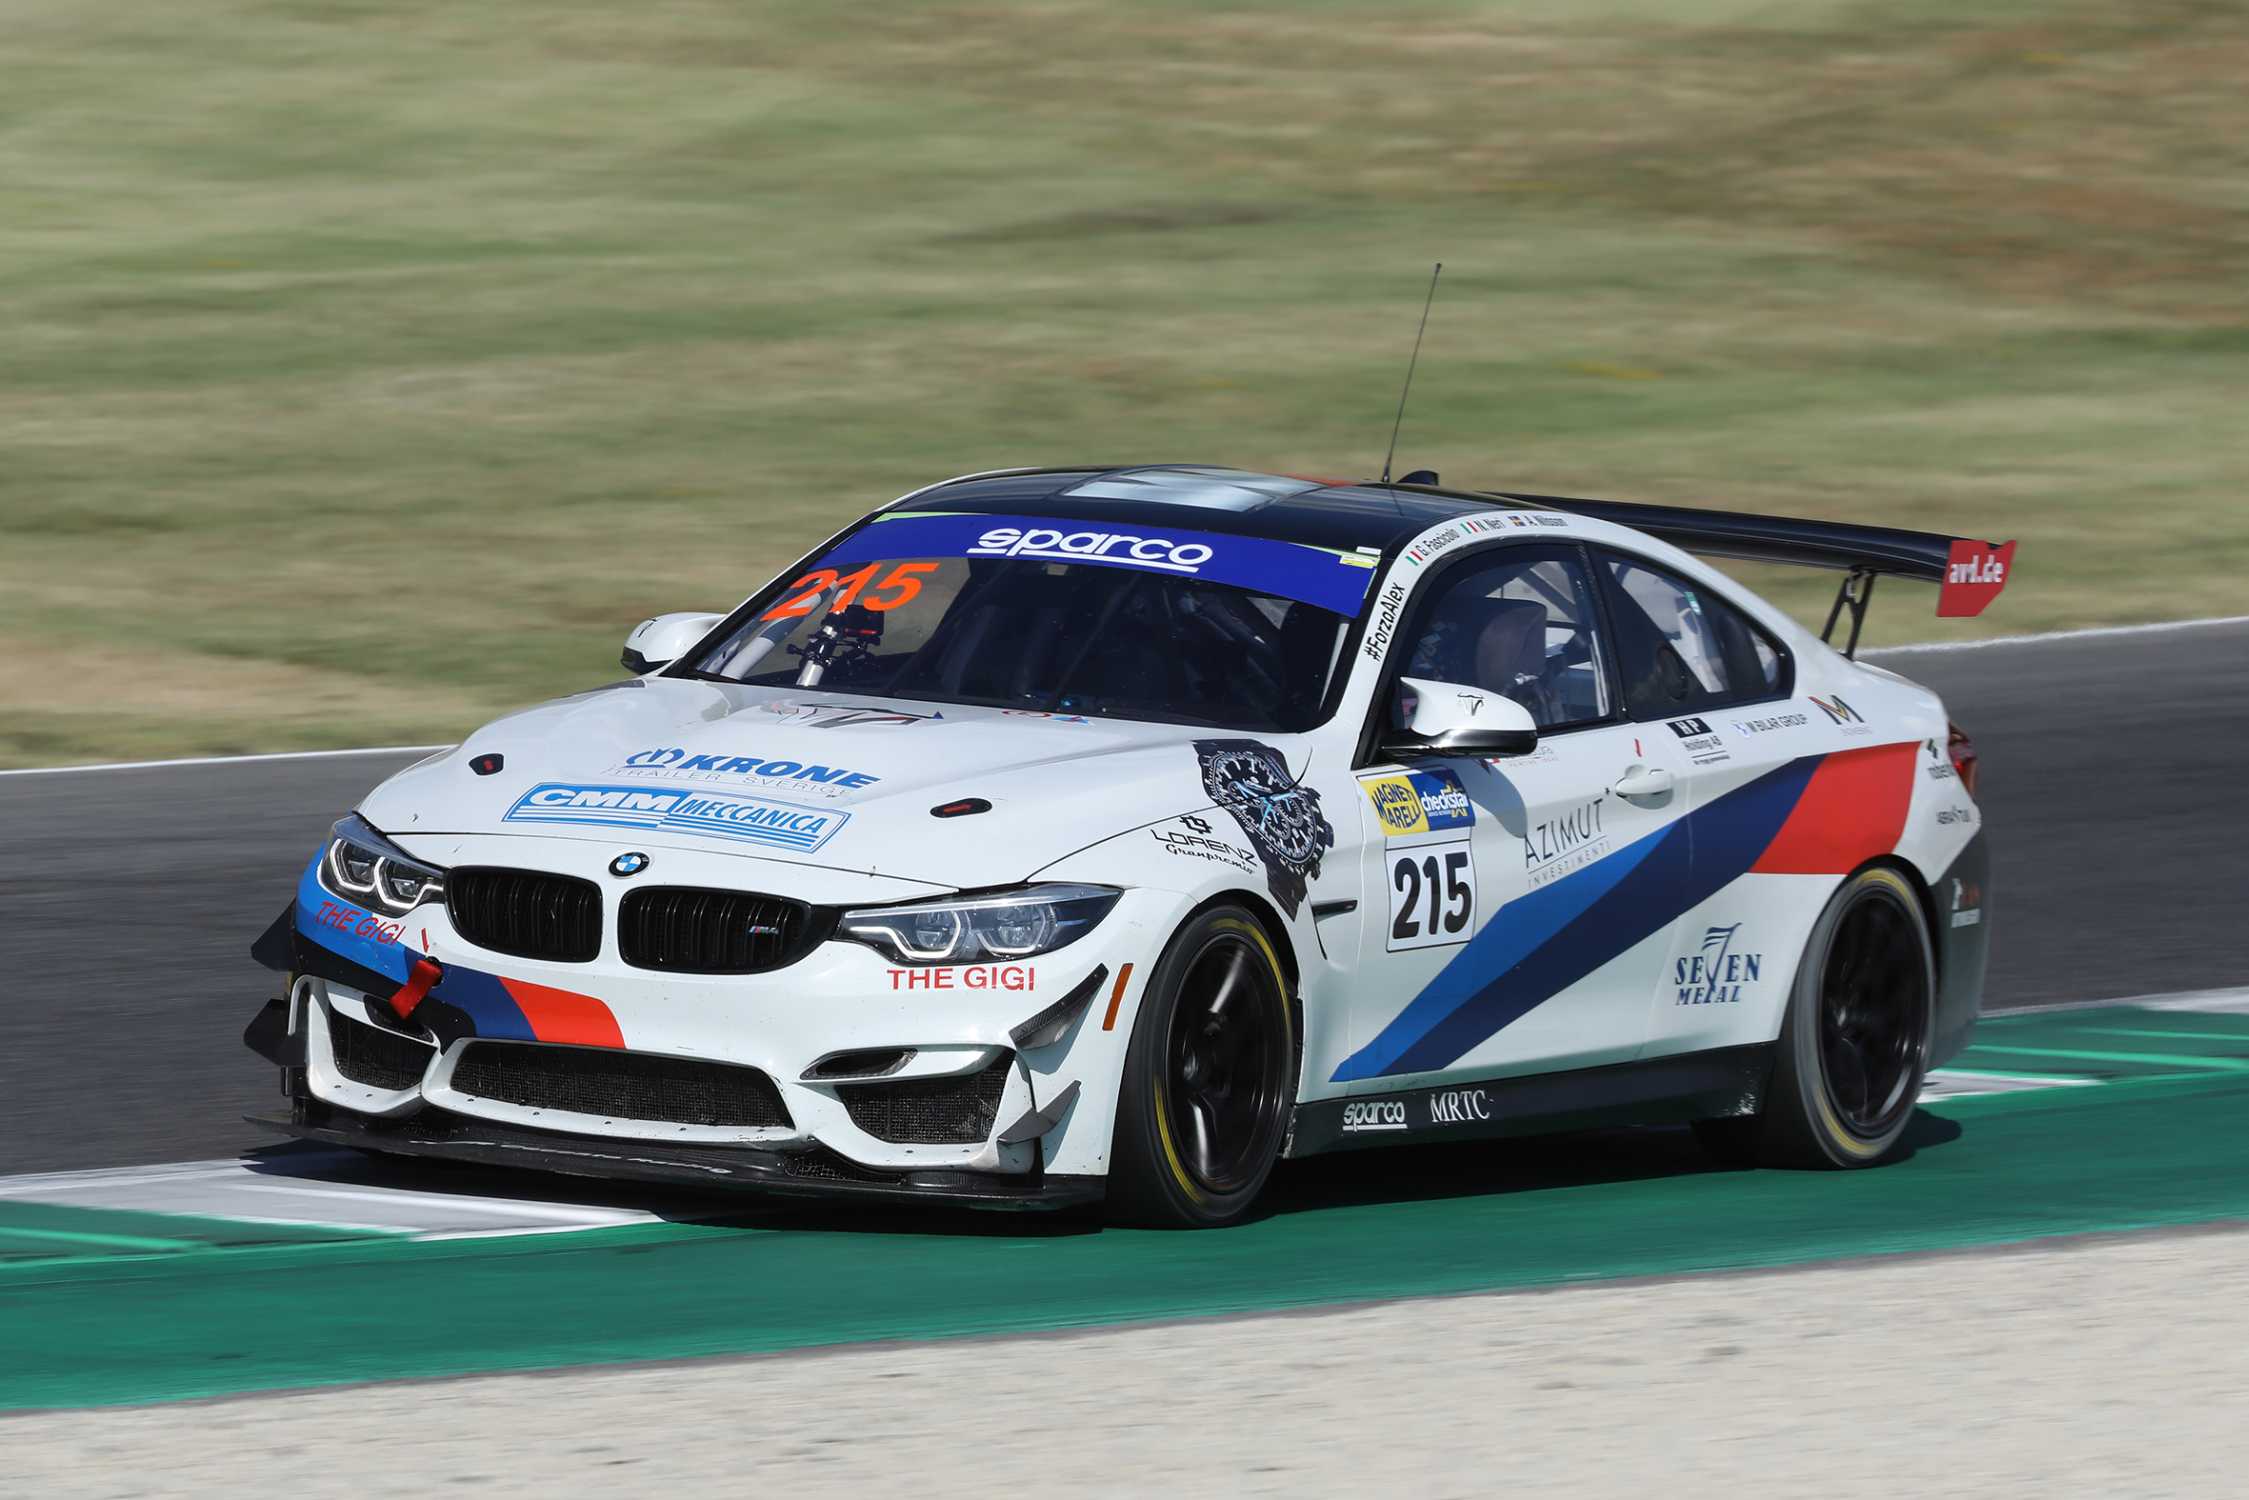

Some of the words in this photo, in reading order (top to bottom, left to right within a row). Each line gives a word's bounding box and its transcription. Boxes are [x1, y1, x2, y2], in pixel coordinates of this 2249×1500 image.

[969, 527, 1213, 572] sparco
[1949, 554, 2004, 583] avd.de
[760, 562, 940, 621] 215
[1364, 582, 1405, 662] #ForzaAlex
[677, 754, 881, 789] KRONE
[527, 788, 683, 814] CMM
[675, 798, 831, 833] MECCANICA
[1151, 829, 1258, 867] LORENZ
[1524, 798, 1604, 868] AZIMUT
[1392, 851, 1473, 940] 215
[315, 901, 361, 932] THE
[355, 916, 407, 945] GIGI
[887, 967, 954, 990] THE
[963, 966, 1035, 991] GIGI
[1342, 1102, 1408, 1132] sparco
[1431, 1090, 1490, 1122] MRTC
